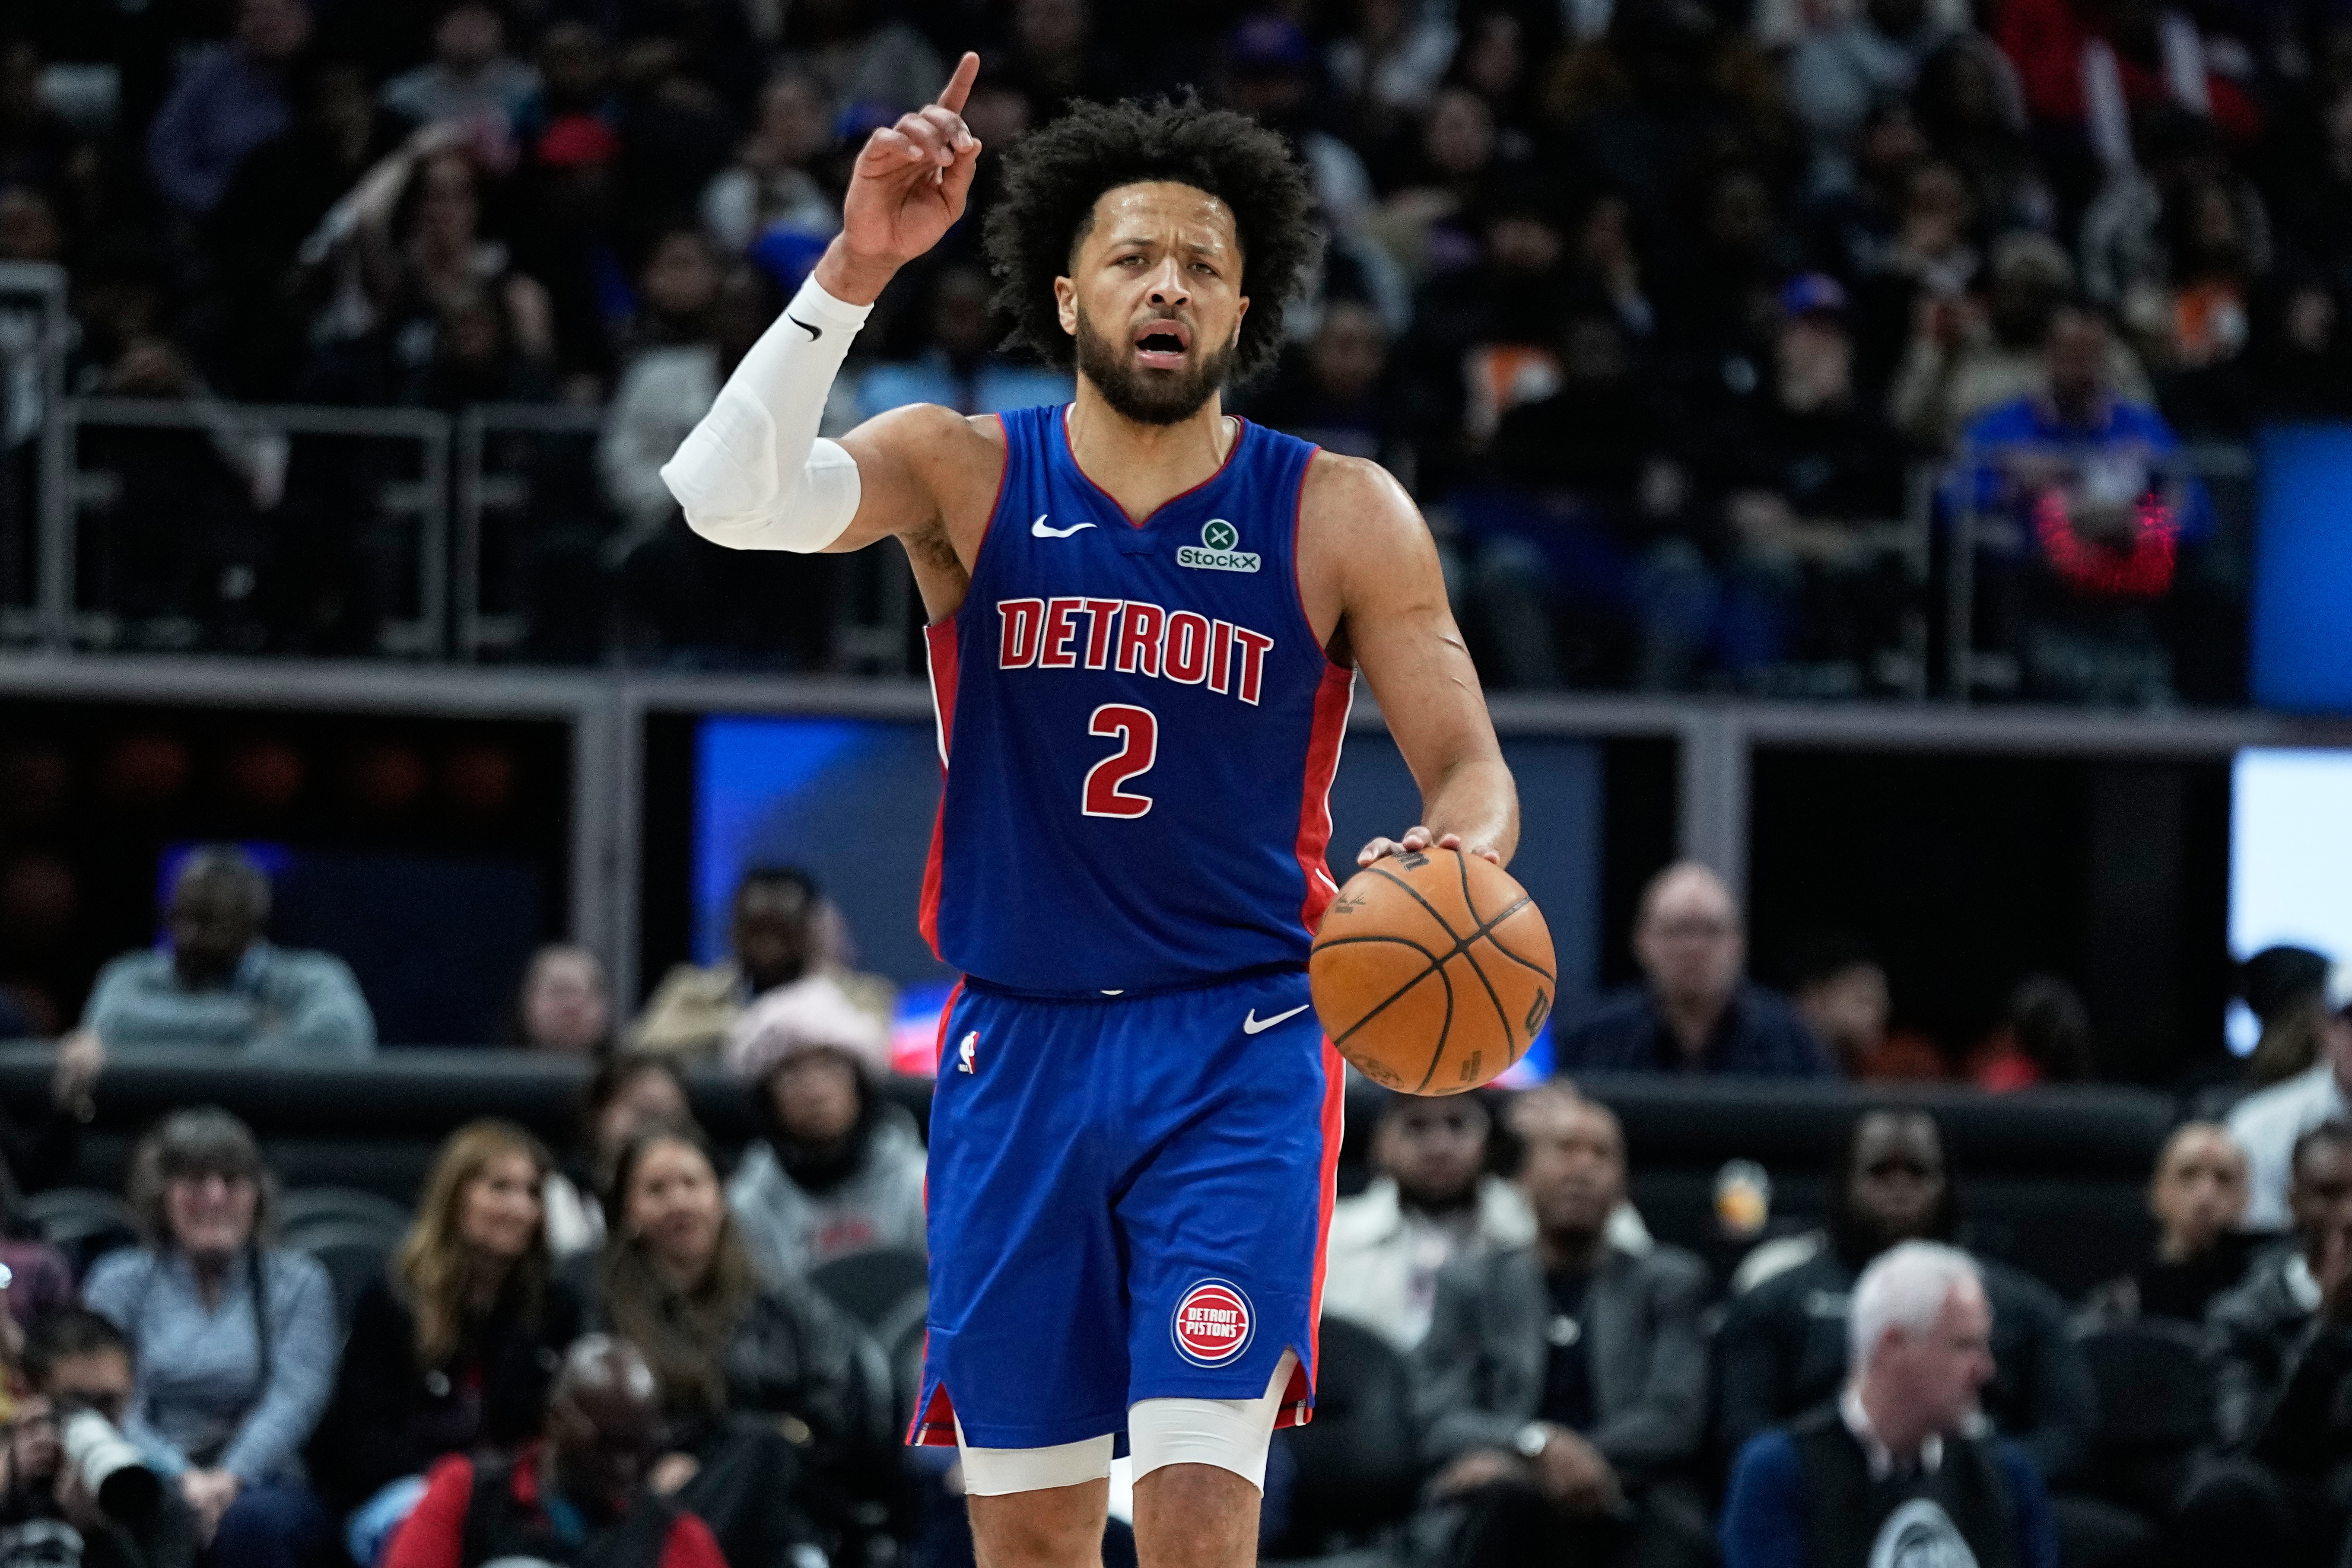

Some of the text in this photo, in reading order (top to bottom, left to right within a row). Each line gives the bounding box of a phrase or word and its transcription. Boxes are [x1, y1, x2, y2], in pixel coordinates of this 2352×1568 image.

[1180, 549, 1257, 570] StockX
[997, 596, 1274, 706] DETROIT
[1082, 703, 1158, 819] 2
[1188, 1307, 1238, 1323] DETROIT
[1185, 1321, 1238, 1338] PISTONS
